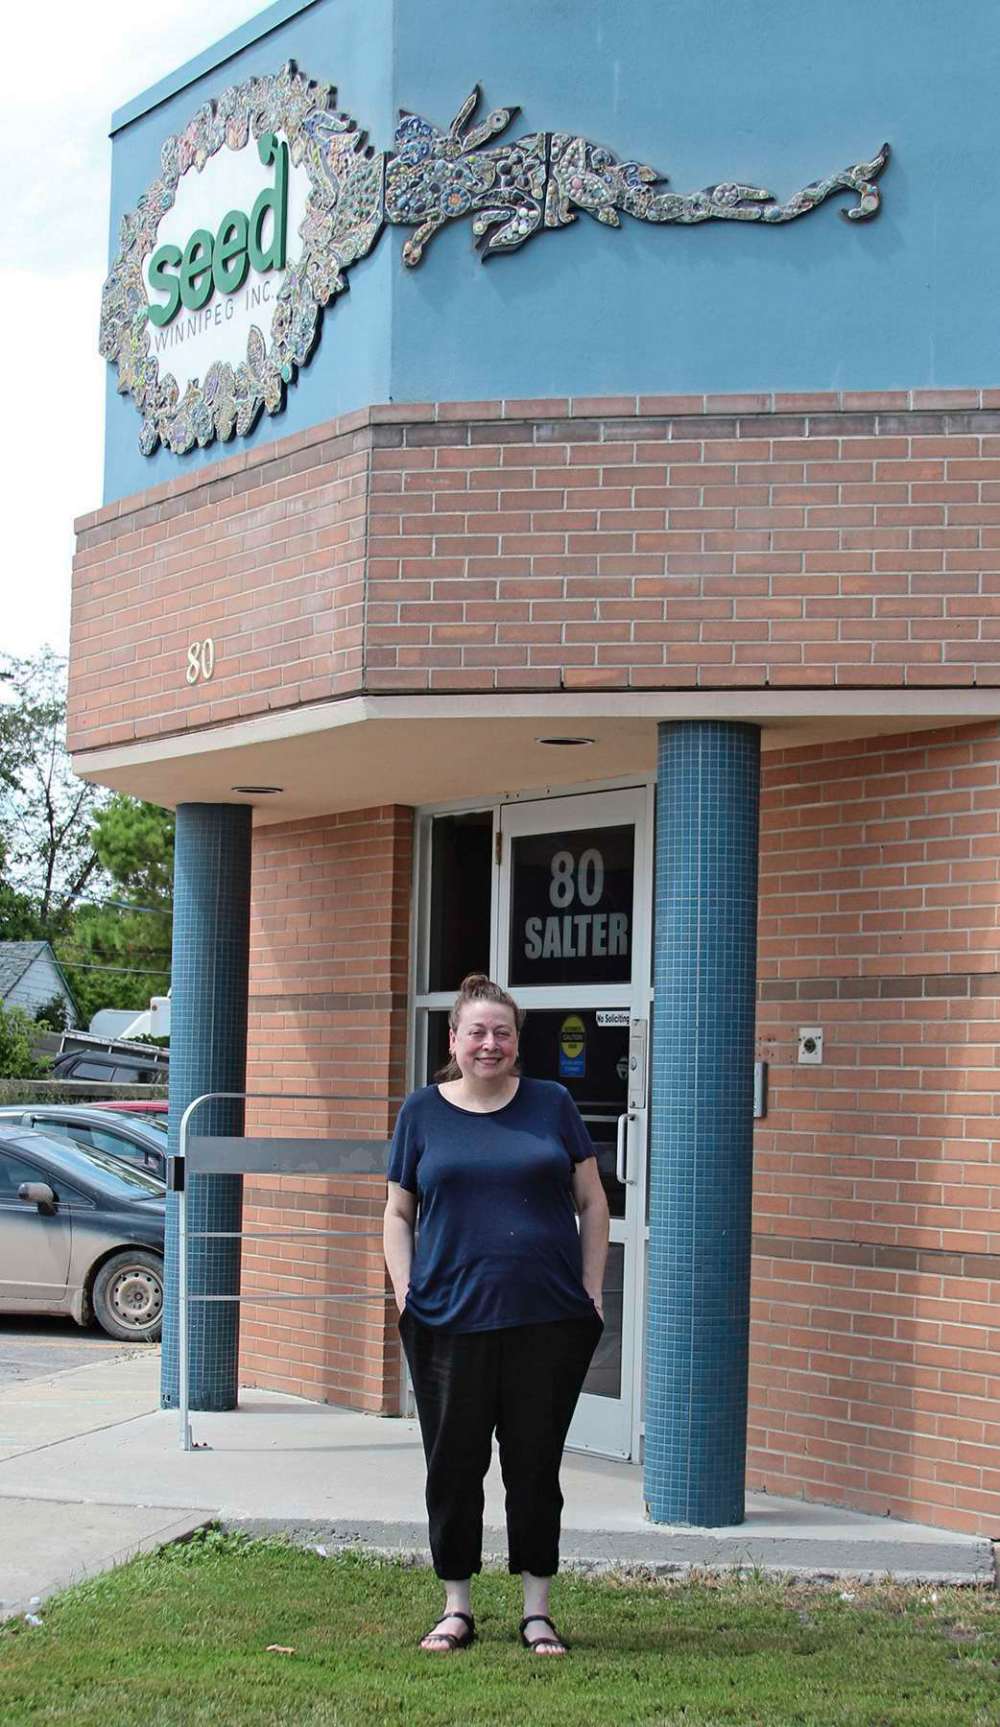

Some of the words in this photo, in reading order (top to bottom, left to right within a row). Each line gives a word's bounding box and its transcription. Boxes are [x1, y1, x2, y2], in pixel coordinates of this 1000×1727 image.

[148, 131, 288, 328] seed
[154, 298, 234, 352] WINNIPEG
[186, 638, 214, 685] 80
[549, 848, 605, 909] 80
[524, 912, 629, 960] SALTER
[597, 1015, 604, 1023] No
[605, 1014, 630, 1025] Soliciting
